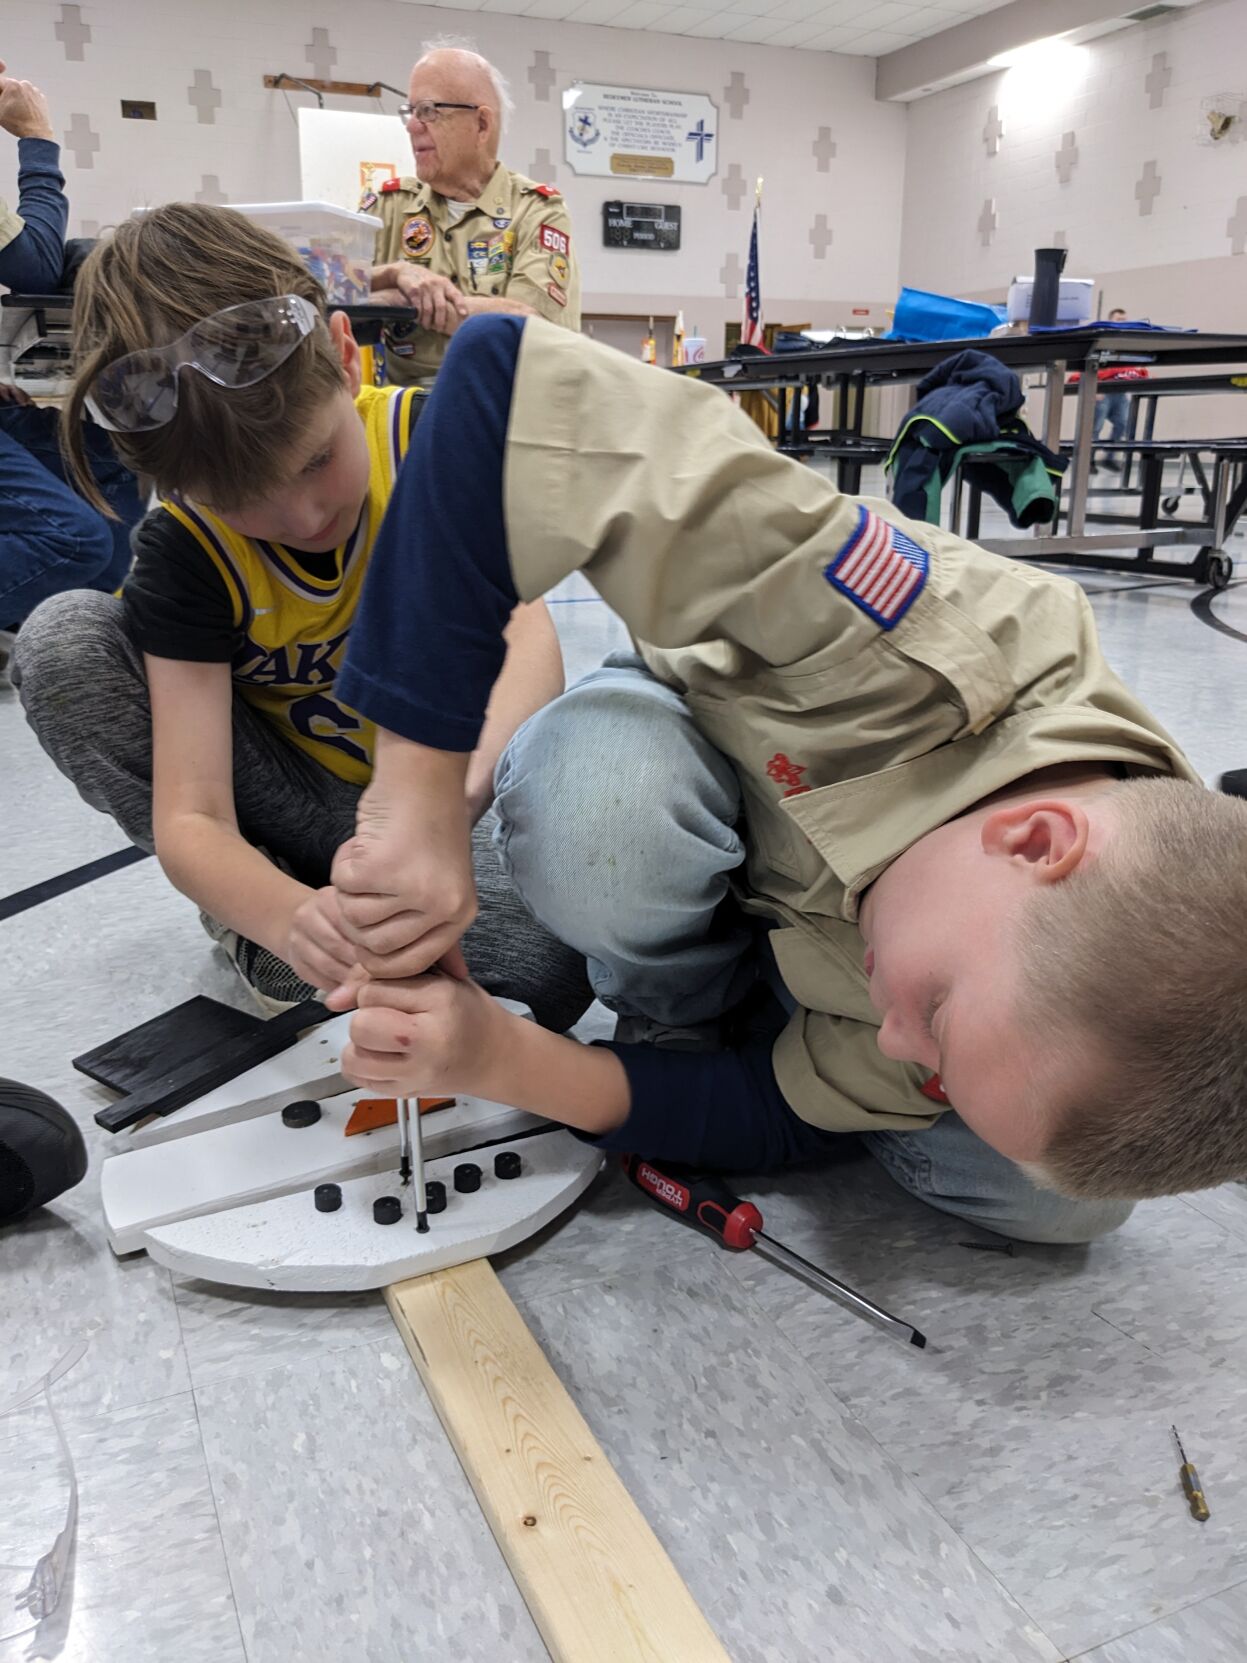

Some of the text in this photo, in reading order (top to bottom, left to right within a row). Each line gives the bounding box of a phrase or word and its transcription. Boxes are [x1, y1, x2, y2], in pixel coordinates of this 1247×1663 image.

[632, 96, 660, 104] LUTHERAN
[608, 218, 678, 231] HOME GUEST
[543, 229, 566, 253] 506
[633, 232, 655, 240] PERIOD
[641, 1167, 683, 1202] TOUGH
[656, 1187, 683, 1206] HYPER
